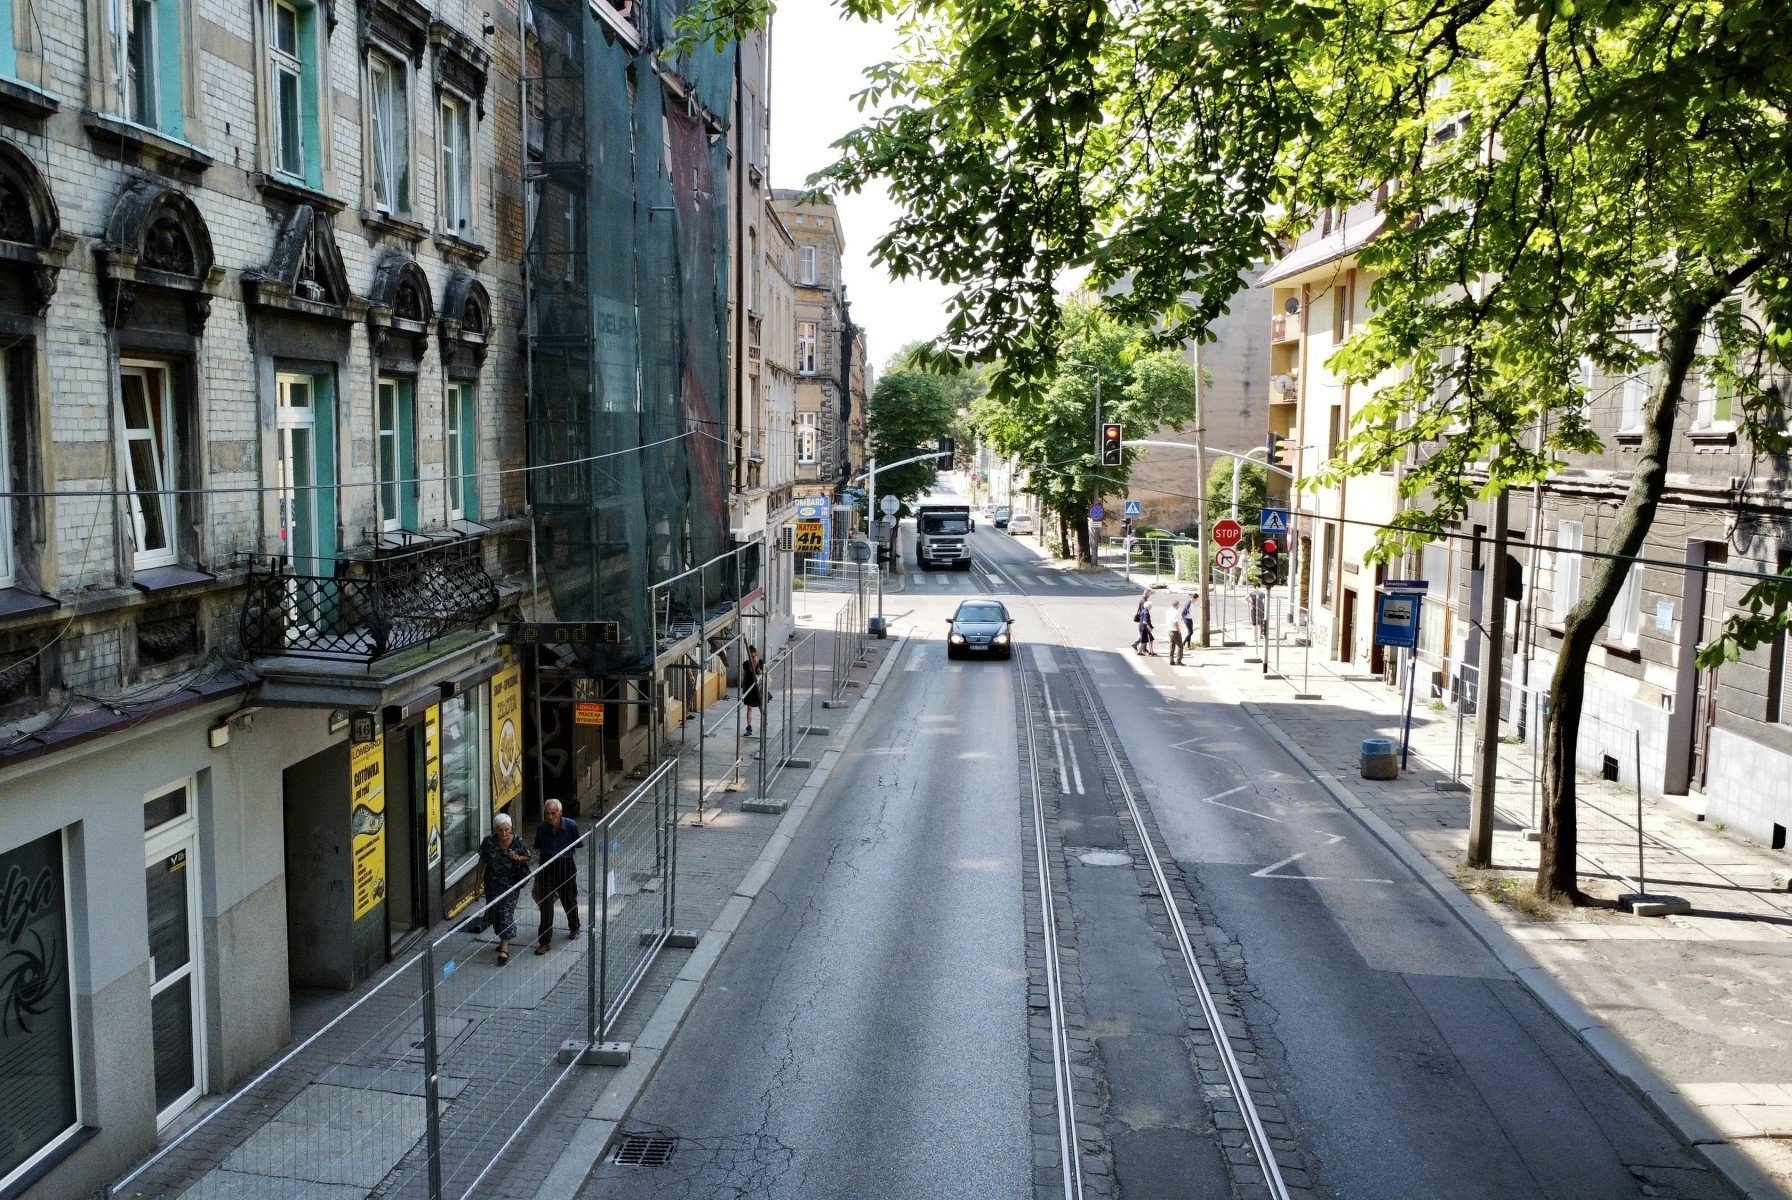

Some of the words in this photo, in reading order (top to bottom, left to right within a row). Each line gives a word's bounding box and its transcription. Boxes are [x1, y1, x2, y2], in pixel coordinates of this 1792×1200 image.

[796, 532, 822, 545] 4h
[1215, 529, 1239, 538] STOP
[356, 724, 370, 736] 46
